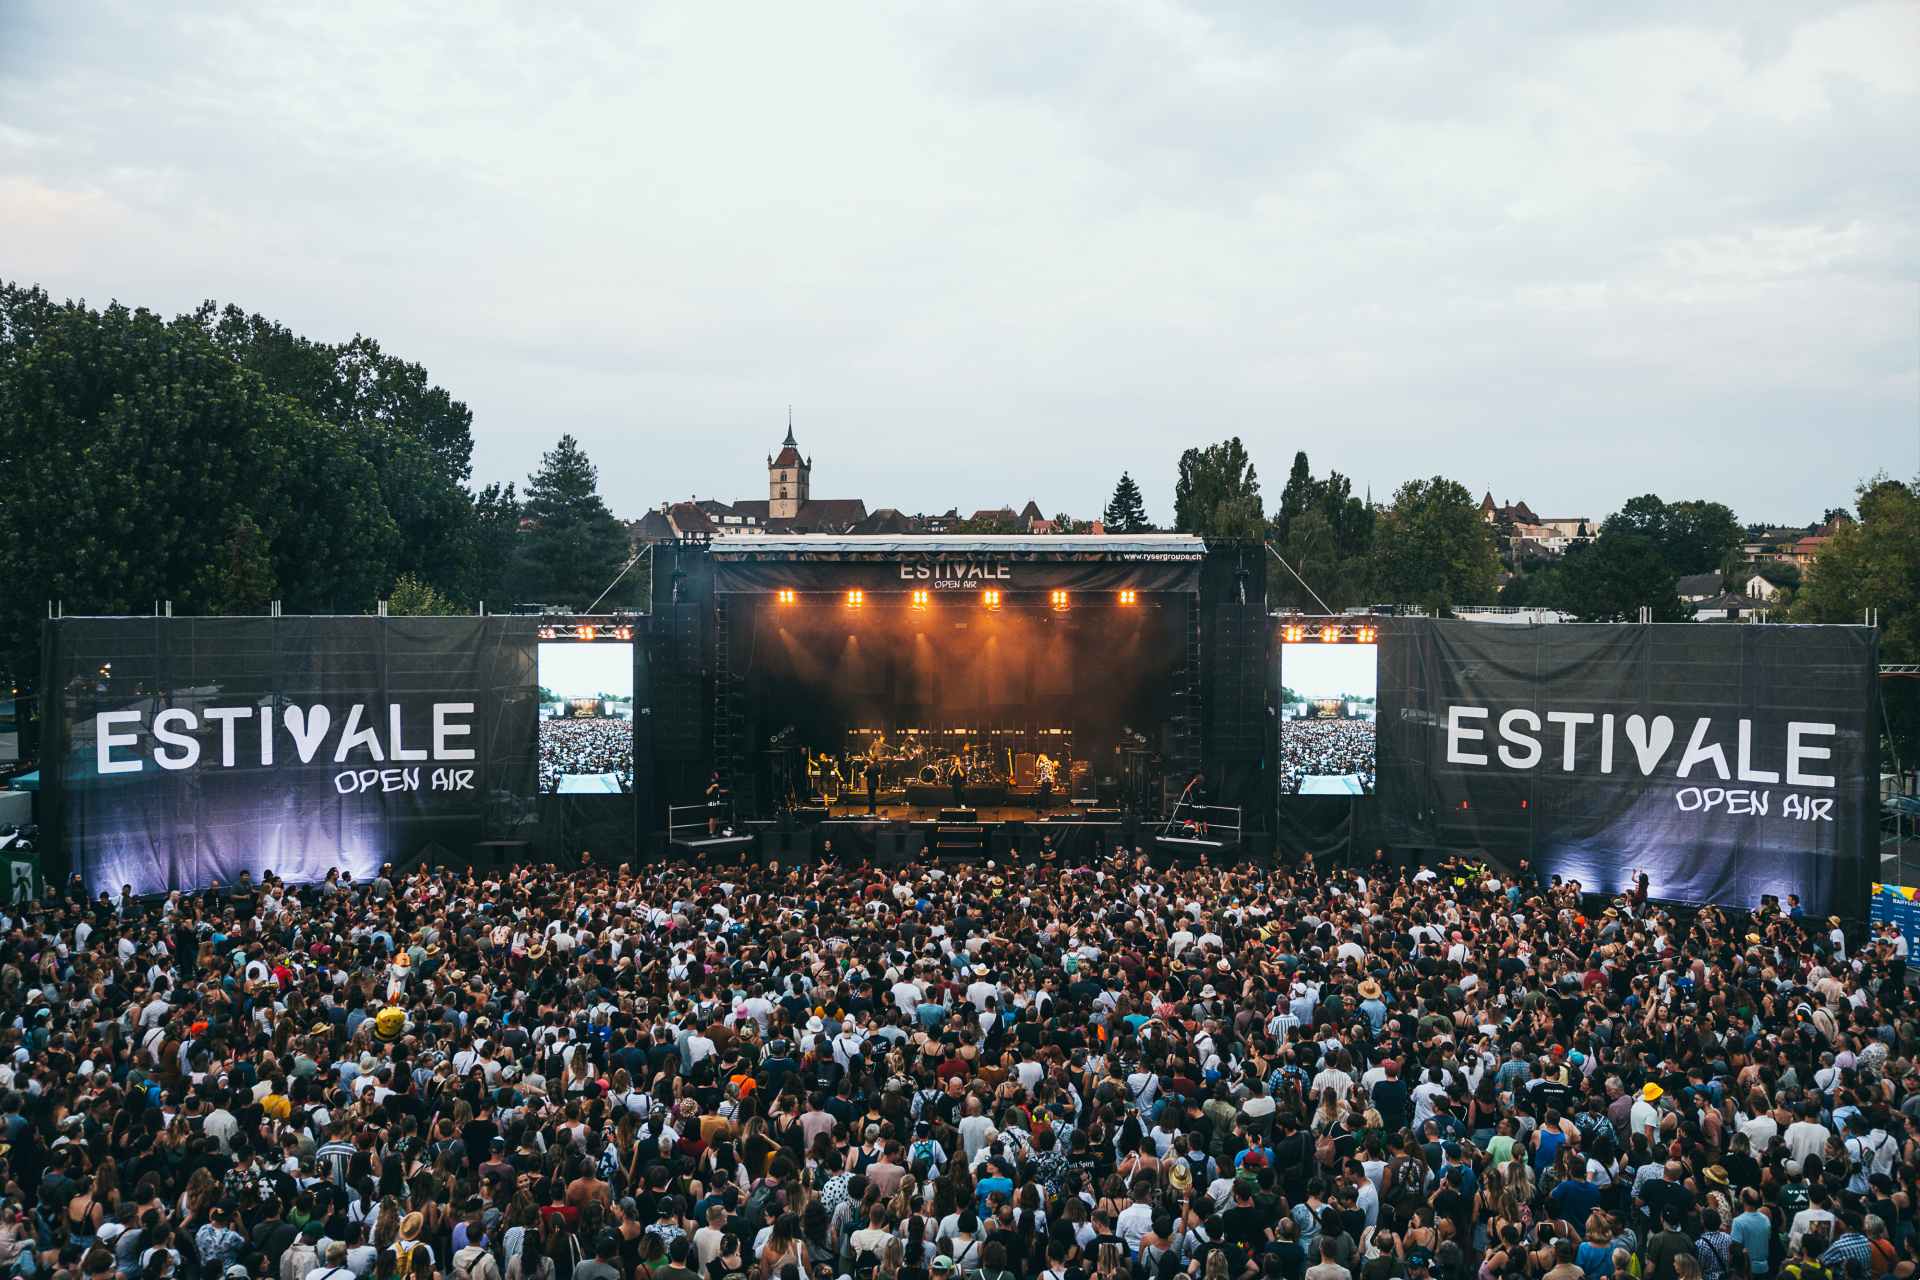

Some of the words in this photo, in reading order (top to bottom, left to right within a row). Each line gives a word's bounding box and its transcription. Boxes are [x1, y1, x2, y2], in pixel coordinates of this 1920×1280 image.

[900, 562, 1011, 579] ESTIVALE
[934, 580, 960, 589] OPEN
[963, 580, 977, 589] AIR
[96, 702, 476, 774] ESTIVALE
[1446, 705, 1836, 788] ESTIVALE
[334, 768, 420, 794] OPEN
[431, 767, 475, 792] AIR
[1675, 787, 1769, 816] OPEN
[1782, 793, 1834, 822] AIR
